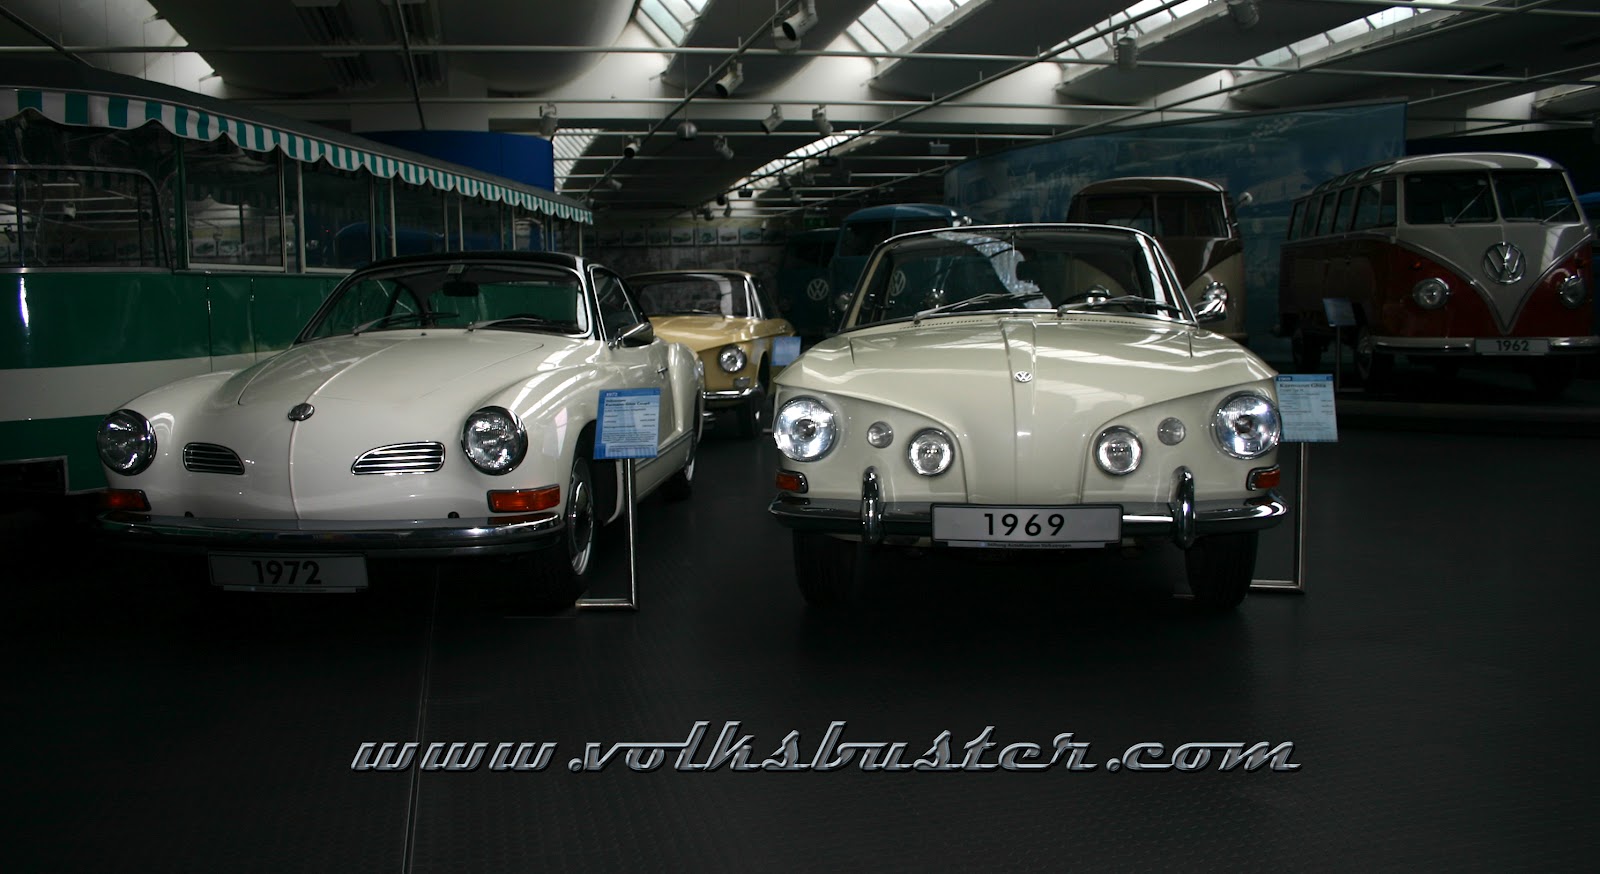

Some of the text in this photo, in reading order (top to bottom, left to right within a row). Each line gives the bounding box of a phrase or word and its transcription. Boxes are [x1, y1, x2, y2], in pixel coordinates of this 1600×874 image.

[1496, 340, 1529, 351] 1962
[984, 513, 1065, 536] 1969
[252, 560, 322, 585] 1972
